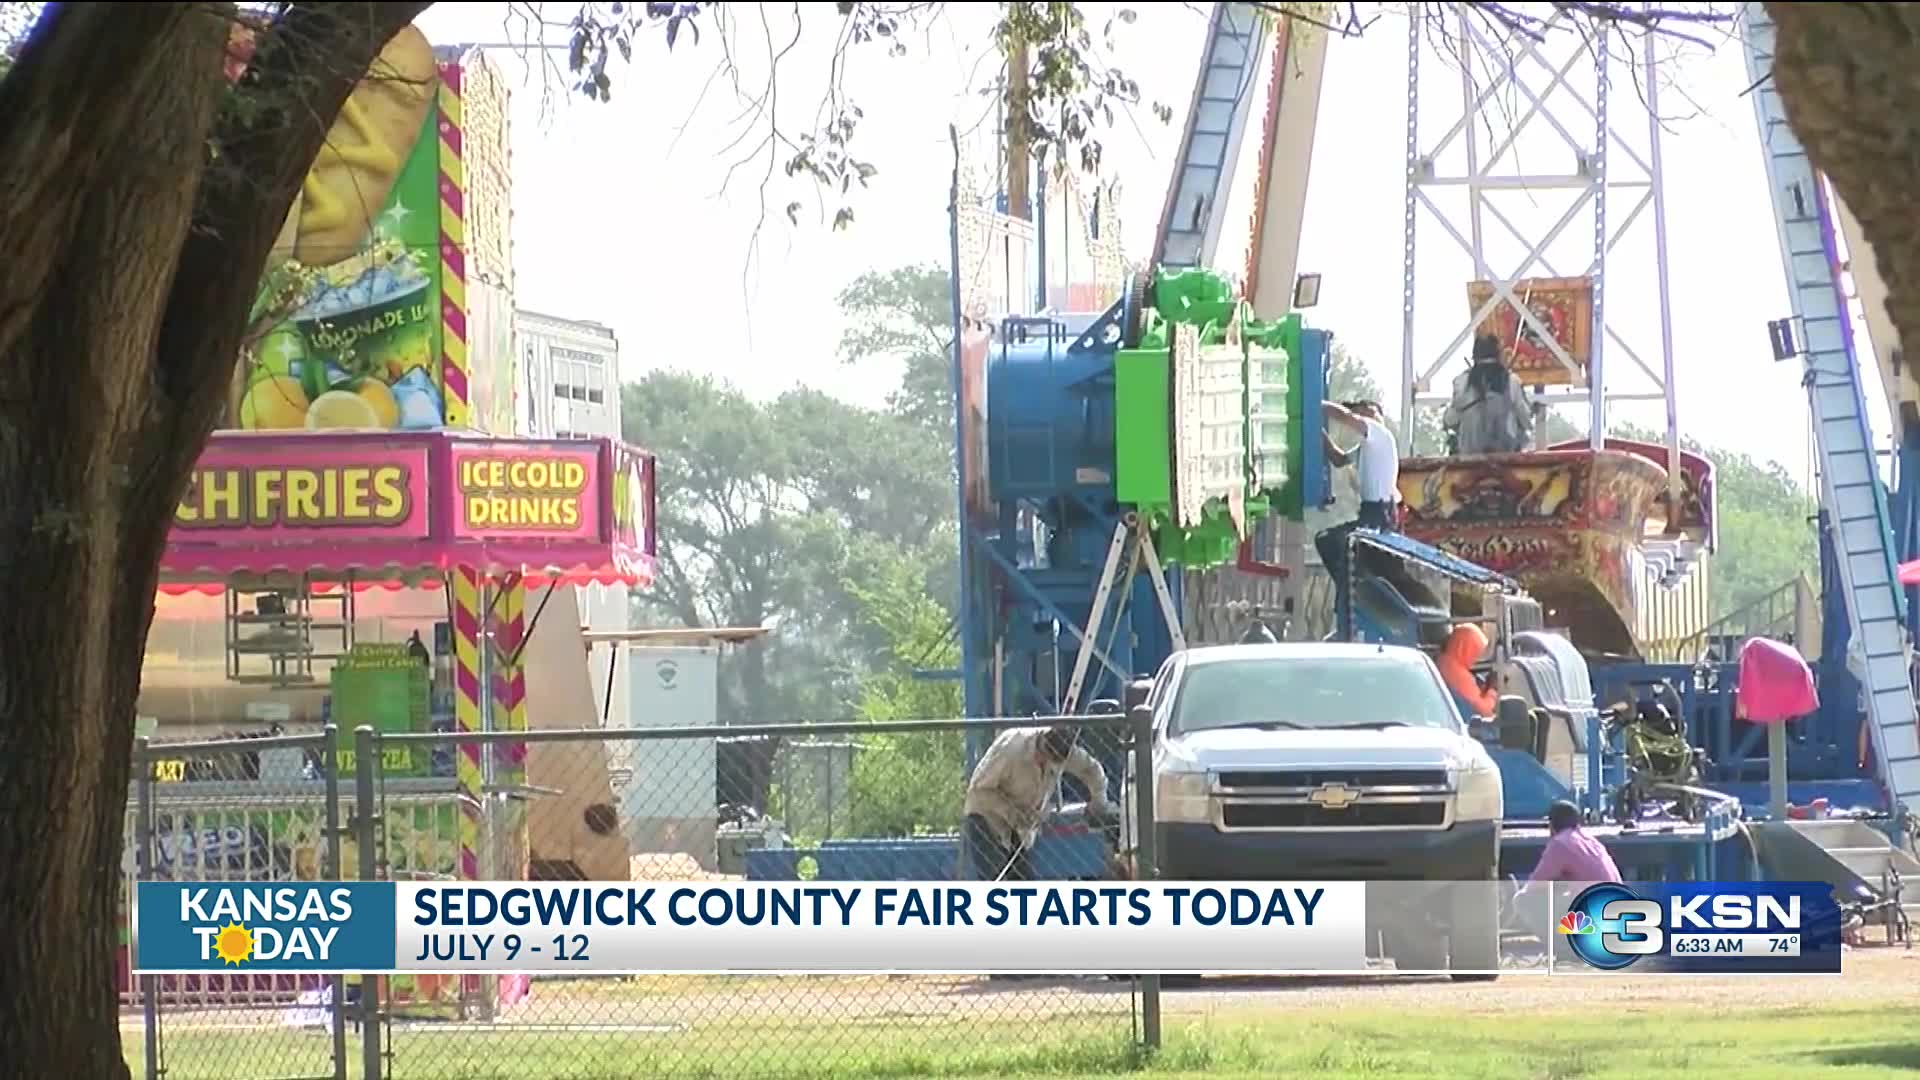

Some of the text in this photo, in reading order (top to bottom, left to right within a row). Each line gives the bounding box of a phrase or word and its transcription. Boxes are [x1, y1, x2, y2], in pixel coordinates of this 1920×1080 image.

[463, 461, 584, 488] ICE COLD
[255, 467, 403, 520] FRIES
[470, 497, 578, 525] DRINKS
